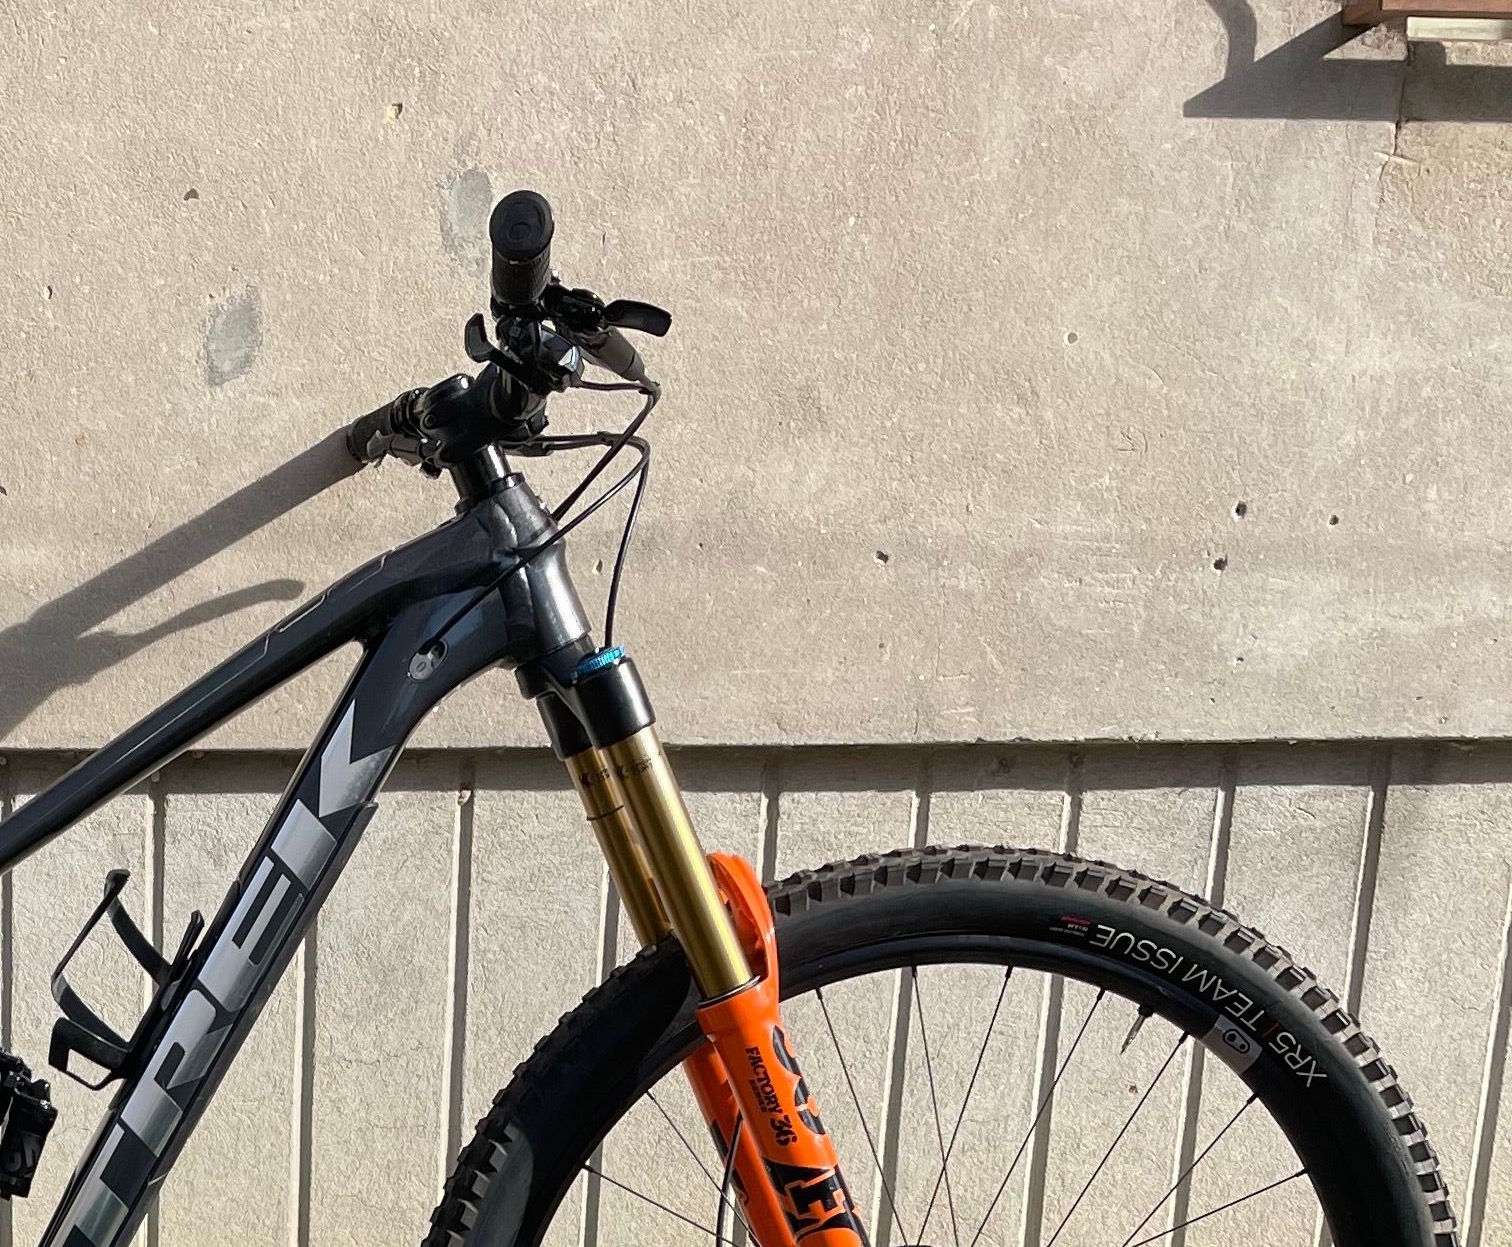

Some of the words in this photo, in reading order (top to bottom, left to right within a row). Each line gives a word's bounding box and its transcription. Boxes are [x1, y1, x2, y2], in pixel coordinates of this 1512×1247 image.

[1089, 923, 1184, 974] ISSUE
[1181, 962, 1265, 1031] TEAM
[1268, 1031, 1328, 1088] XR5
[745, 1045, 783, 1121] FACTORY
[769, 1113, 798, 1147] 36
